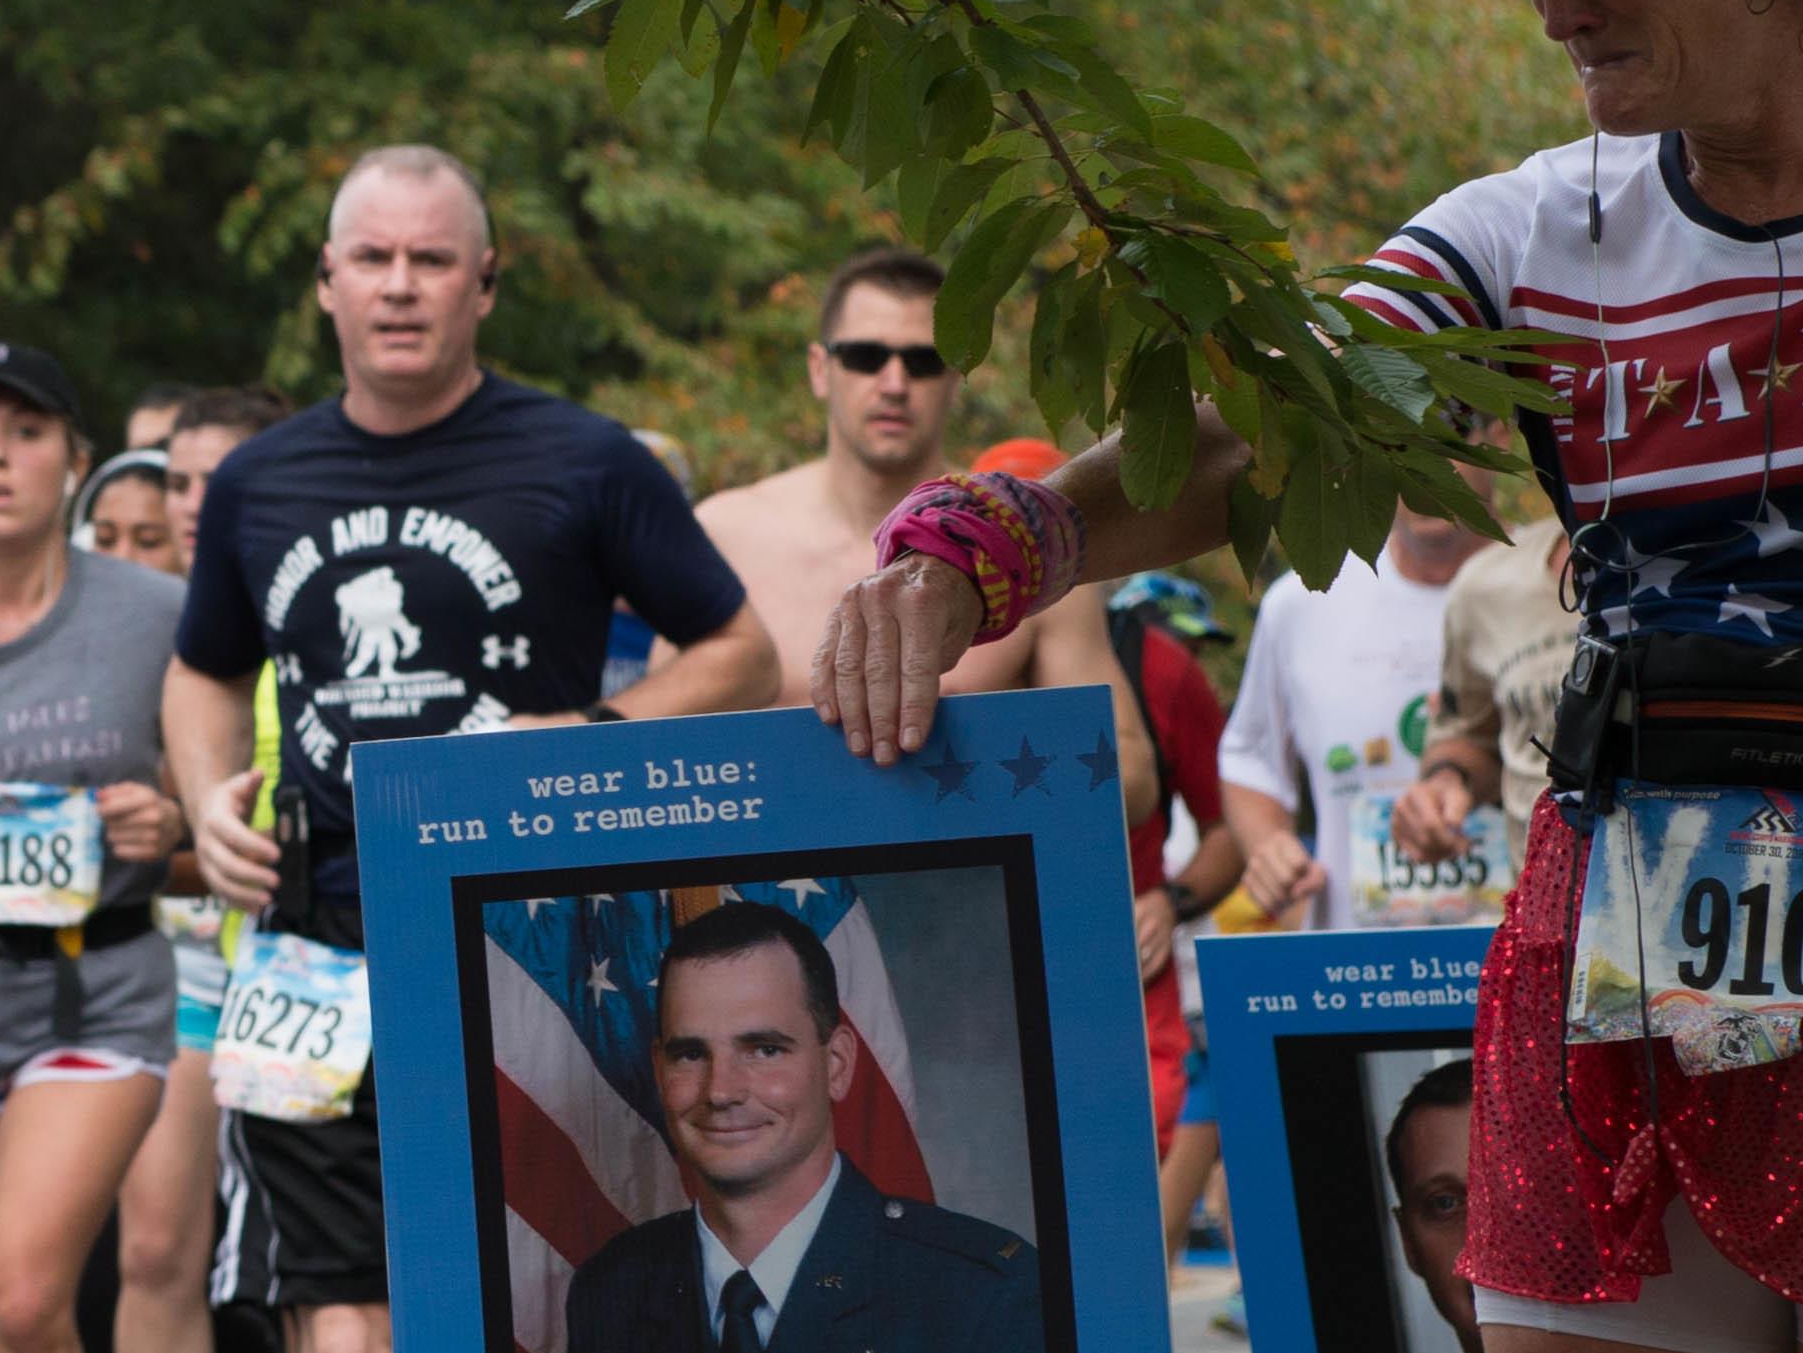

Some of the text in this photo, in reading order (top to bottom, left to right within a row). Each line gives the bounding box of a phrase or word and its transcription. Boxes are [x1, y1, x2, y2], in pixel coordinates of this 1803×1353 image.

[265, 505, 522, 631] HONOR AND EMPOWER
[295, 701, 339, 771] THE
[527, 759, 757, 799] wear blue:
[418, 795, 764, 845] run to remember
[1325, 958, 1481, 983] wear blue
[218, 986, 342, 1060] 16273
[1247, 984, 1479, 1013] run to remembe
